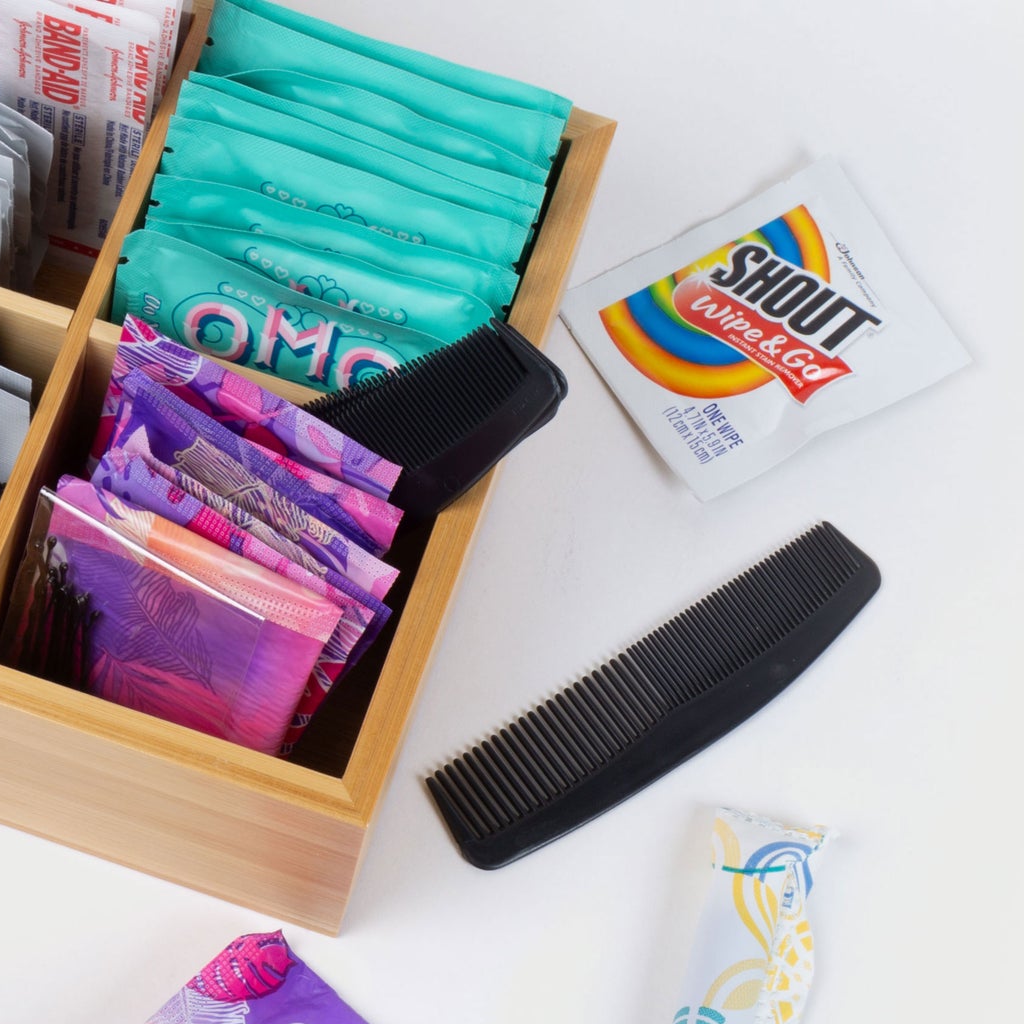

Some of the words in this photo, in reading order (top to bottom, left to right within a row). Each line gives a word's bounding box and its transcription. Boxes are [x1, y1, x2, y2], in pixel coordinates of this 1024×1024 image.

[711, 245, 882, 351] SHOUT
[691, 295, 758, 343] Wipe
[760, 334, 785, 358] &
[782, 348, 825, 382] Go
[755, 350, 776, 368] STAIN
[775, 363, 804, 389] REMOVER
[701, 401, 727, 427] ONE
[716, 420, 744, 451] WIPE
